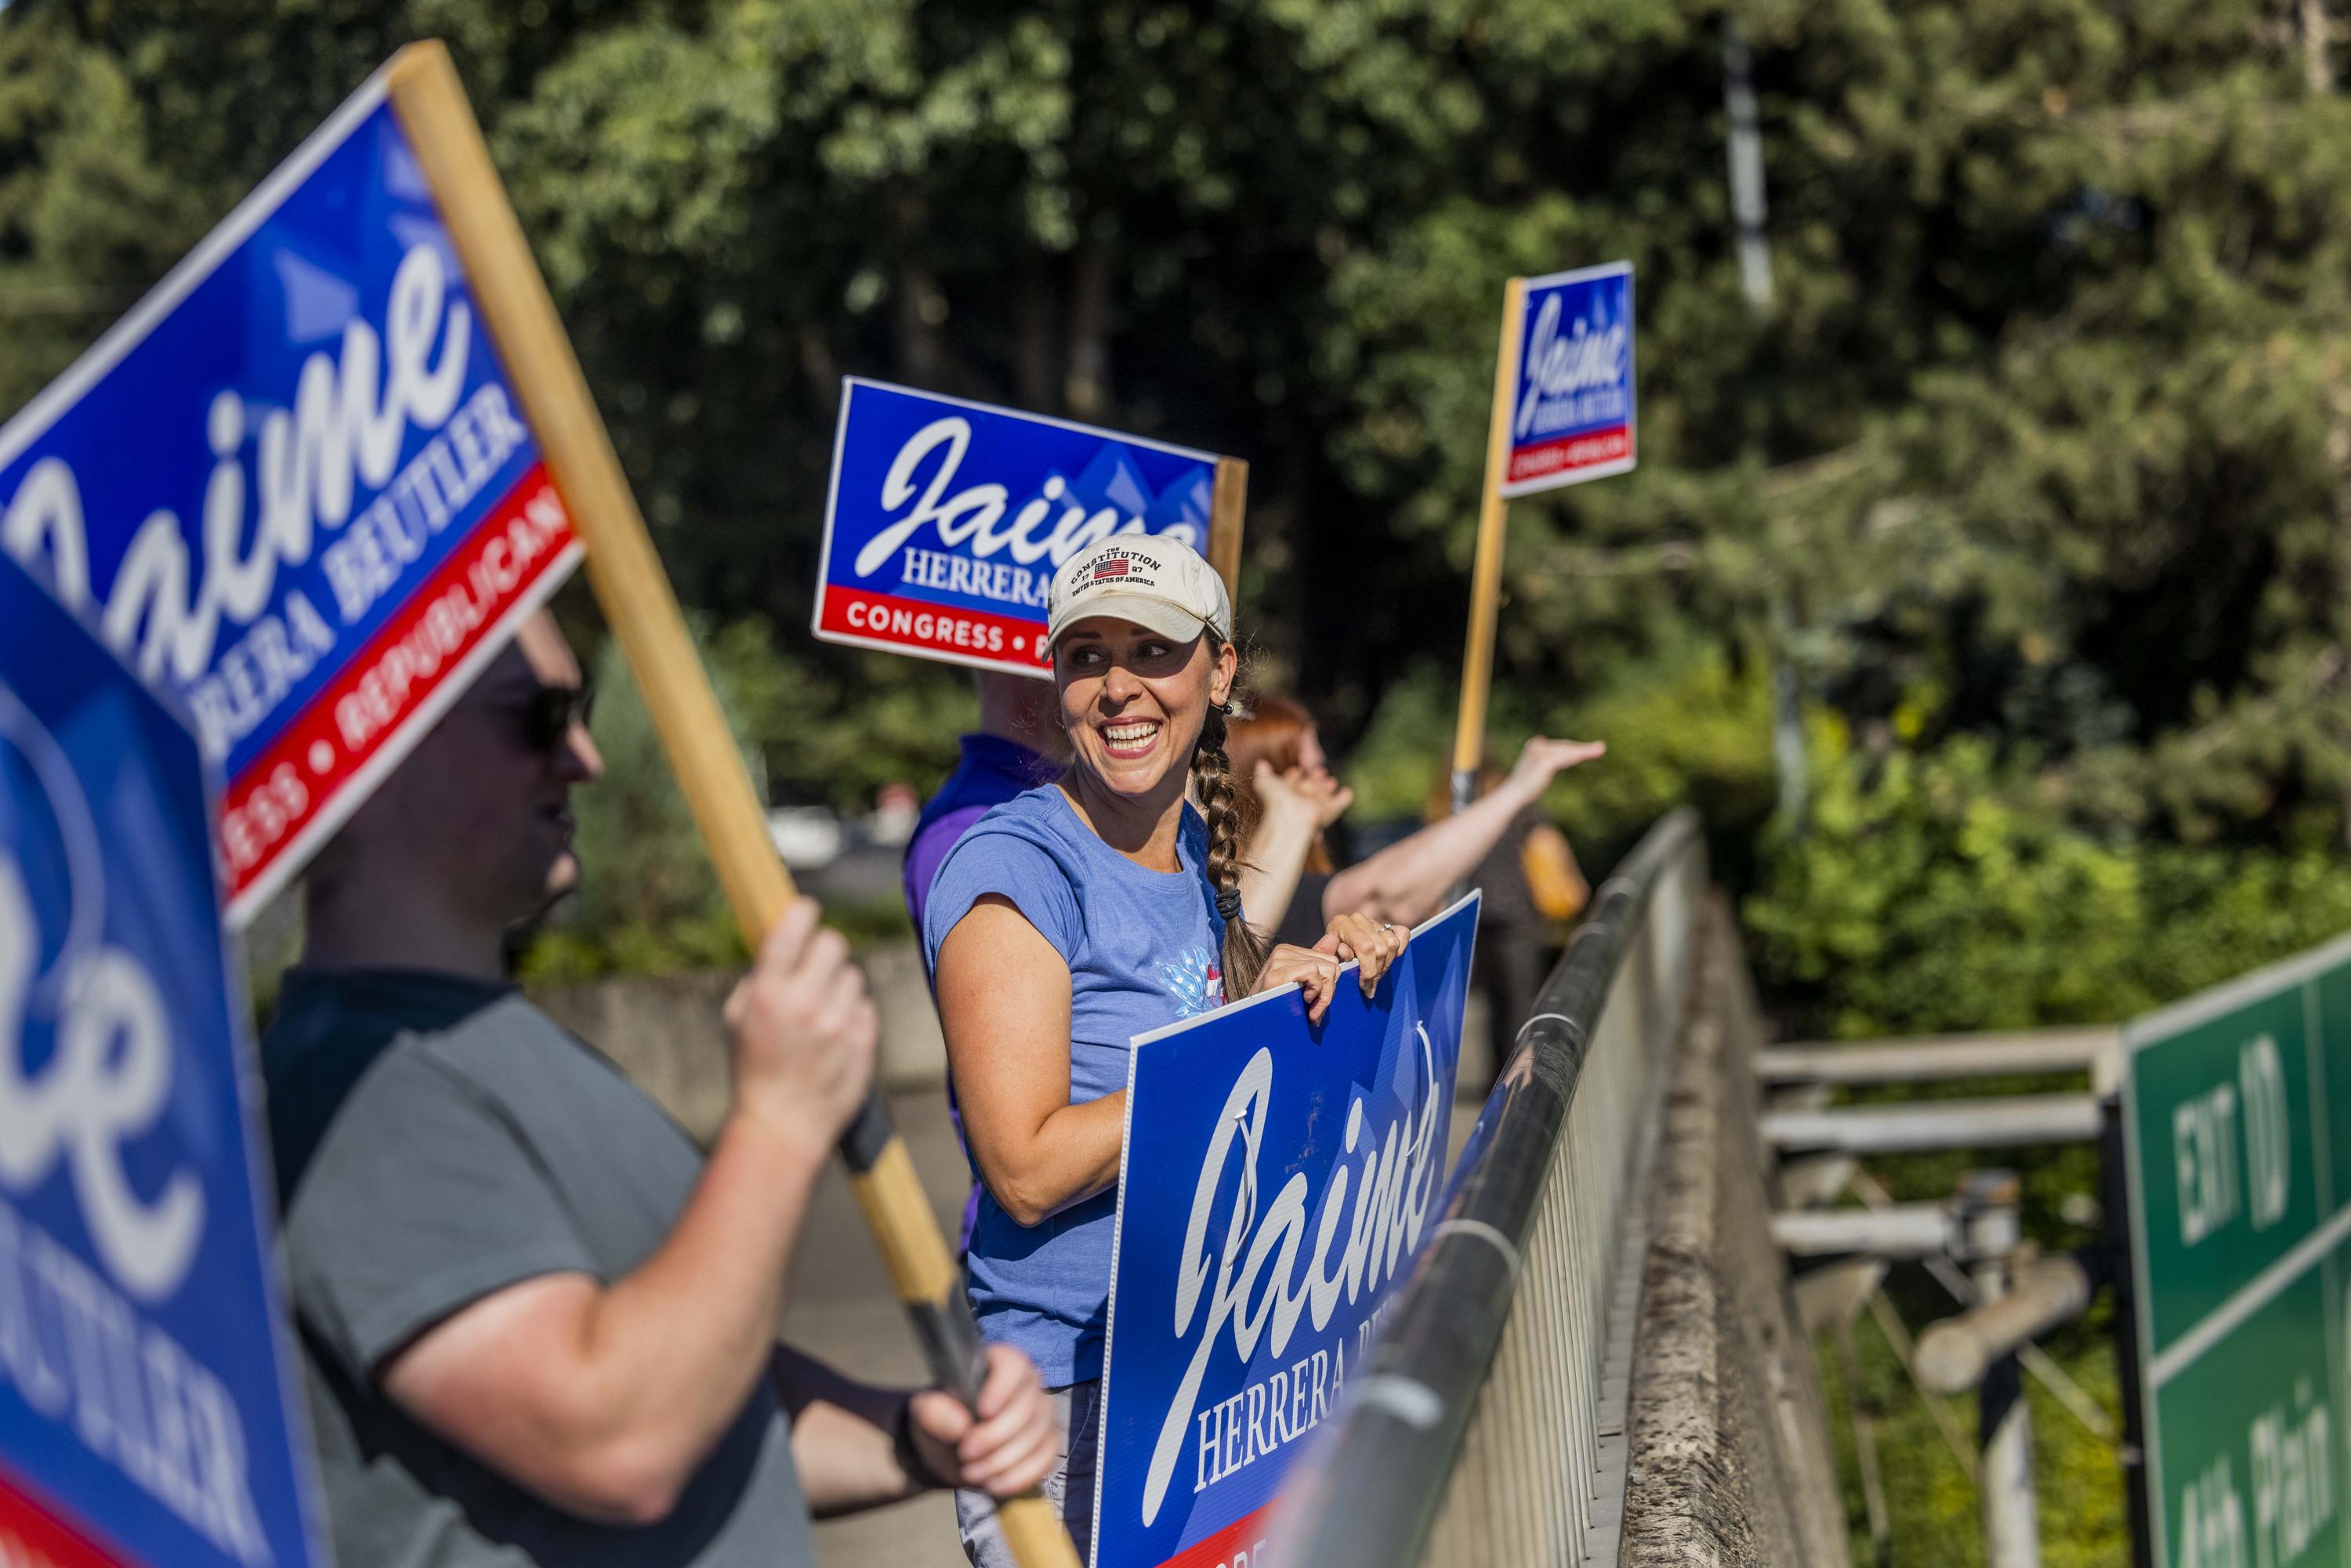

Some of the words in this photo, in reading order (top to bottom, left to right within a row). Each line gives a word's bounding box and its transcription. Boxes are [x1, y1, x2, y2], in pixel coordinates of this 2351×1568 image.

[188, 588, 337, 759] RERA
[321, 384, 528, 623] BEUTLER
[900, 545, 1050, 609] HERRERA
[1070, 551, 1161, 585] CONSTITUTION
[1071, 581, 1090, 596] UNITED
[1089, 577, 1114, 586] STATES
[1124, 577, 1155, 587] AMERICA
[1081, 573, 1090, 582] 17
[335, 484, 572, 752] REPUBLICAN
[846, 601, 1004, 652] CONGRESS
[1142, 1048, 1440, 1528] Jaime
[1194, 1337, 1346, 1494] HERRERA
